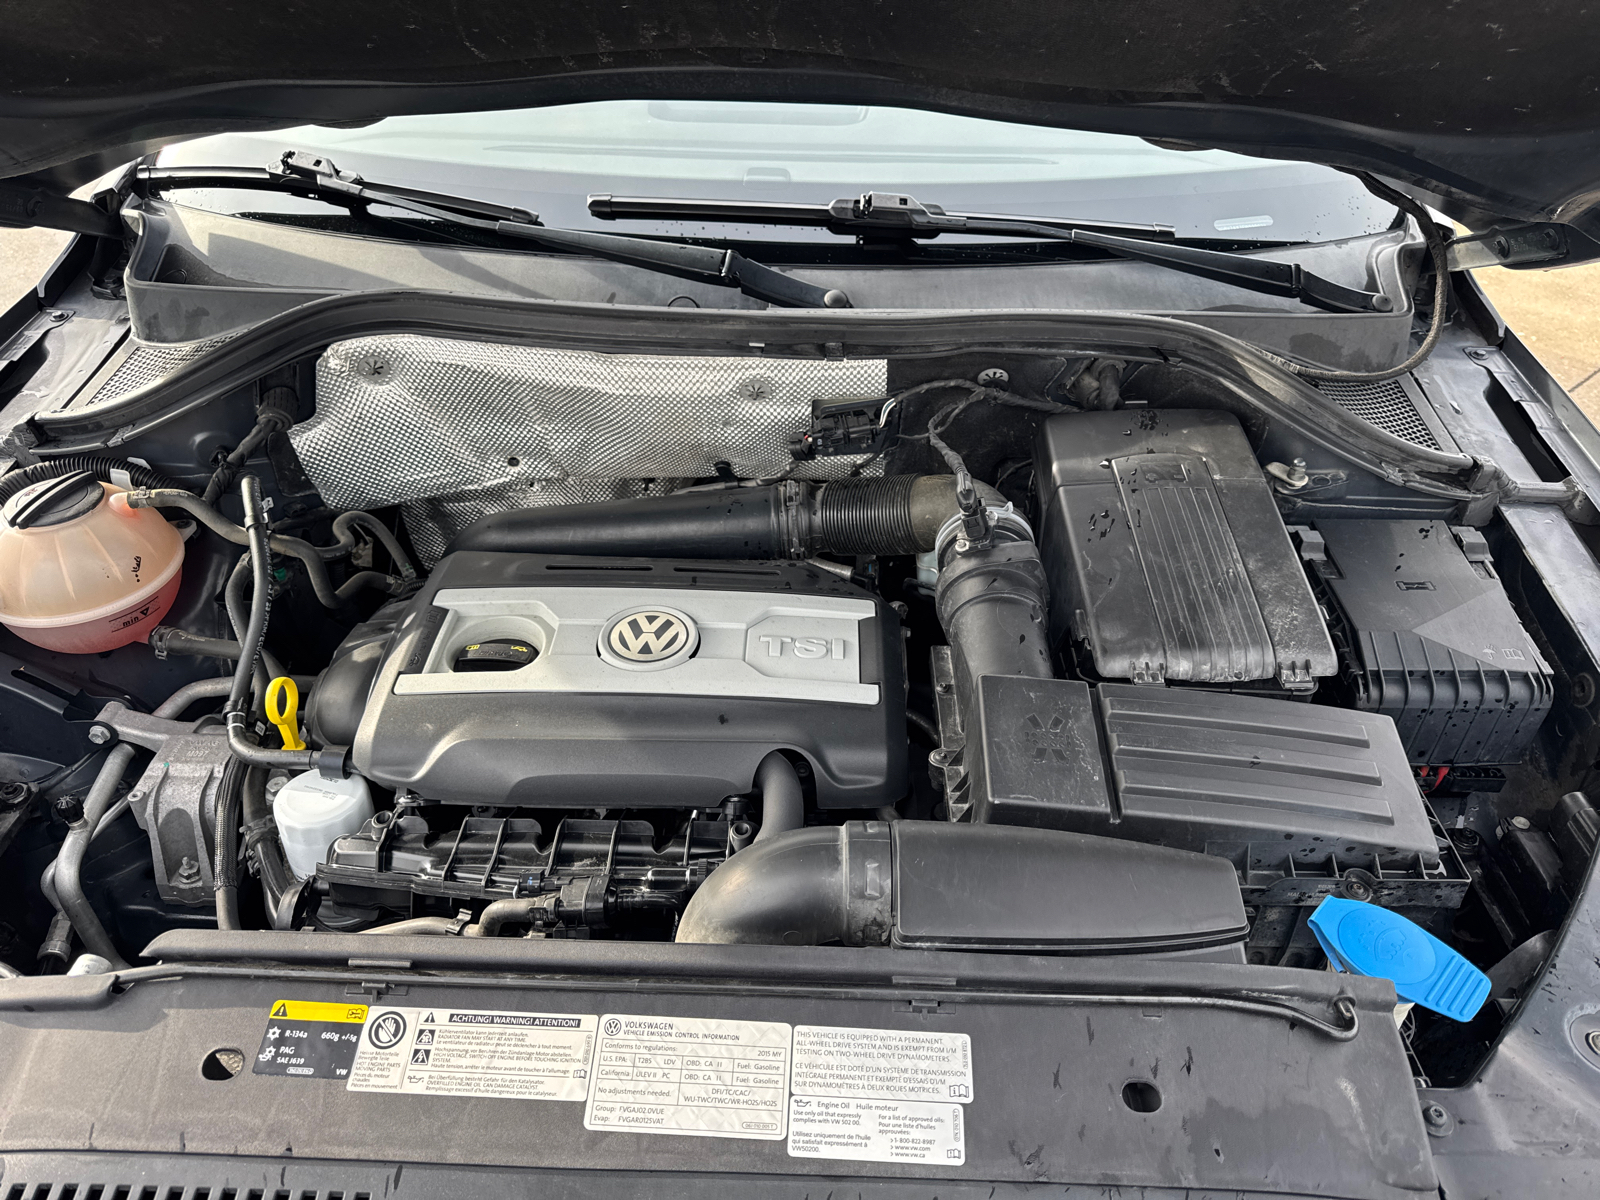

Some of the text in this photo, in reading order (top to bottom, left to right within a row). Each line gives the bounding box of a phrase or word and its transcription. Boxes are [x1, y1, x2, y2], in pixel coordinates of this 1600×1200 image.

[122, 615, 139, 627] min
[759, 634, 845, 659] TSI
[452, 1014, 579, 1027] ACHTUNG! WARNING! ATTENTION!
[624, 1021, 673, 1031] VOLKSWAGEN
[285, 1029, 308, 1038] R-134a
[321, 1031, 340, 1042] 660g
[647, 1030, 673, 1038] EMISSION
[702, 1033, 740, 1041] INFORMATION
[812, 1032, 838, 1040] VEHICLE
[847, 1033, 879, 1042] EQUIPPED
[905, 1036, 943, 1045] PERMANENT
[280, 1046, 295, 1054] PAG
[605, 1042, 633, 1050] Conforms
[643, 1044, 678, 1052] regulations:
[796, 1040, 831, 1048] ALL-WHEEL
[901, 1045, 925, 1053] EXEMPT
[927, 1046, 945, 1054] FROM
[796, 1048, 823, 1056] TESTING
[836, 1050, 875, 1059] TWO-WHEEL
[877, 1052, 896, 1060] DRIVE
[276, 1056, 305, 1065] SAE J639
[738, 1062, 780, 1071] Fuel: Gasoline
[805, 1062, 835, 1071] VÉHICULE
[848, 1064, 864, 1072] DOTÉ
[883, 1066, 909, 1075] SYSTÈME
[920, 1068, 966, 1077] TRANSMISSION
[336, 1068, 348, 1076] VW
[829, 1073, 865, 1081] PERMANENT
[736, 1076, 780, 1085] Fuel: Gasoline
[608, 1087, 645, 1095] adjustments
[647, 1089, 671, 1097] needed.
[817, 1101, 839, 1110] Engine
[804, 1110, 816, 1118] only
[837, 1112, 861, 1120] expressly
[792, 1138, 800, 1146] qui
